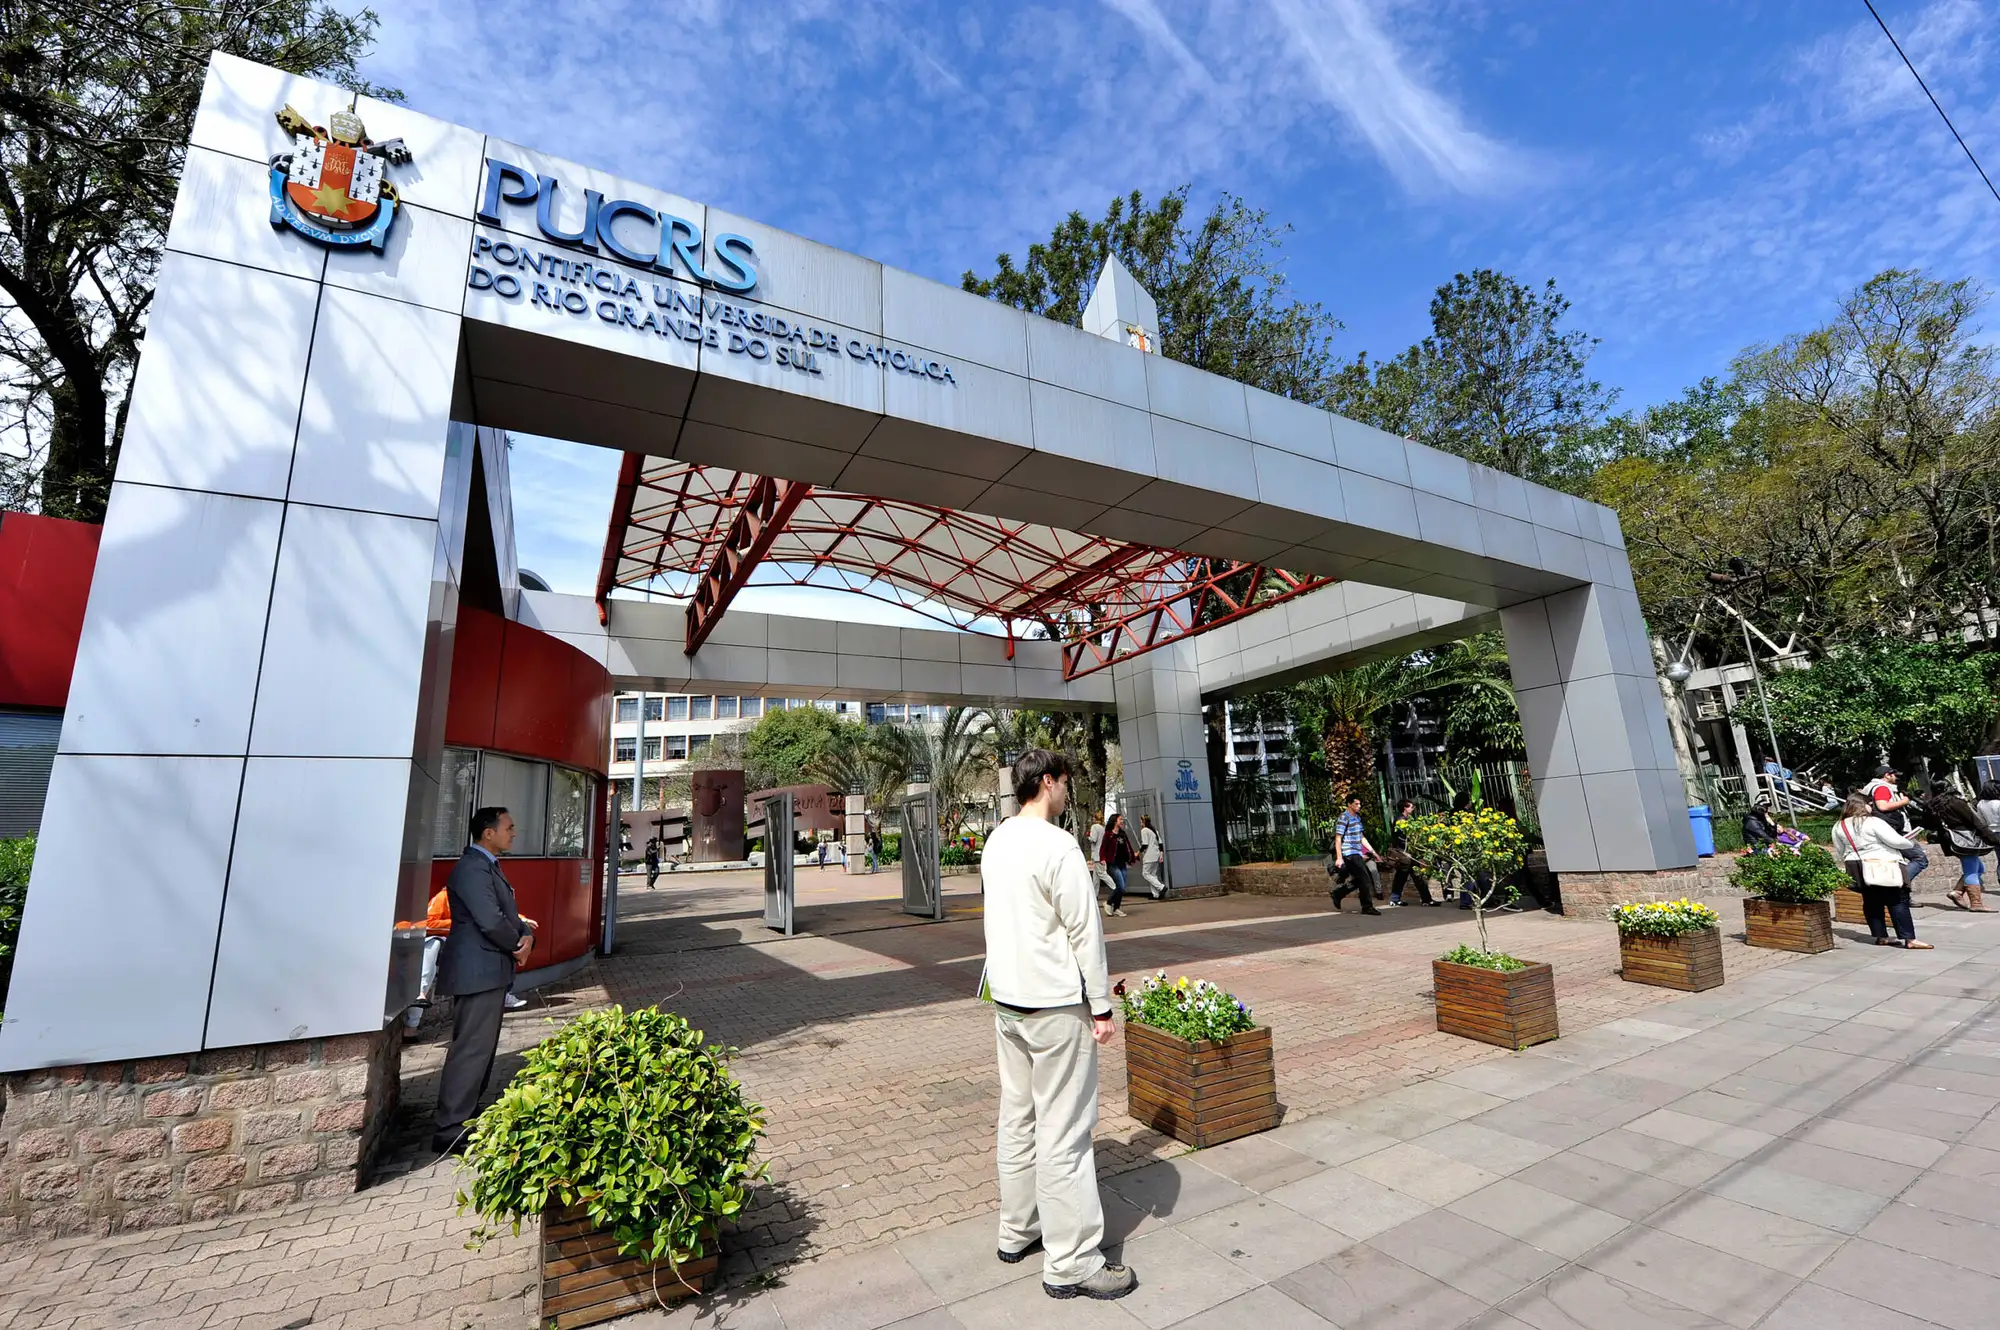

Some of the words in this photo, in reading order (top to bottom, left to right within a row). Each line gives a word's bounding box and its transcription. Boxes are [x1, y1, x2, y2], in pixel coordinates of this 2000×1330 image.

[272, 195, 286, 213] AD
[477, 157, 757, 293] PUCRS
[468, 265, 521, 298] DO
[531, 281, 588, 314] RIO
[596, 300, 719, 348] GRANDE
[728, 331, 768, 359] DO
[776, 345, 822, 375] SUL
[653, 285, 840, 353] UNIVERSIDADE
